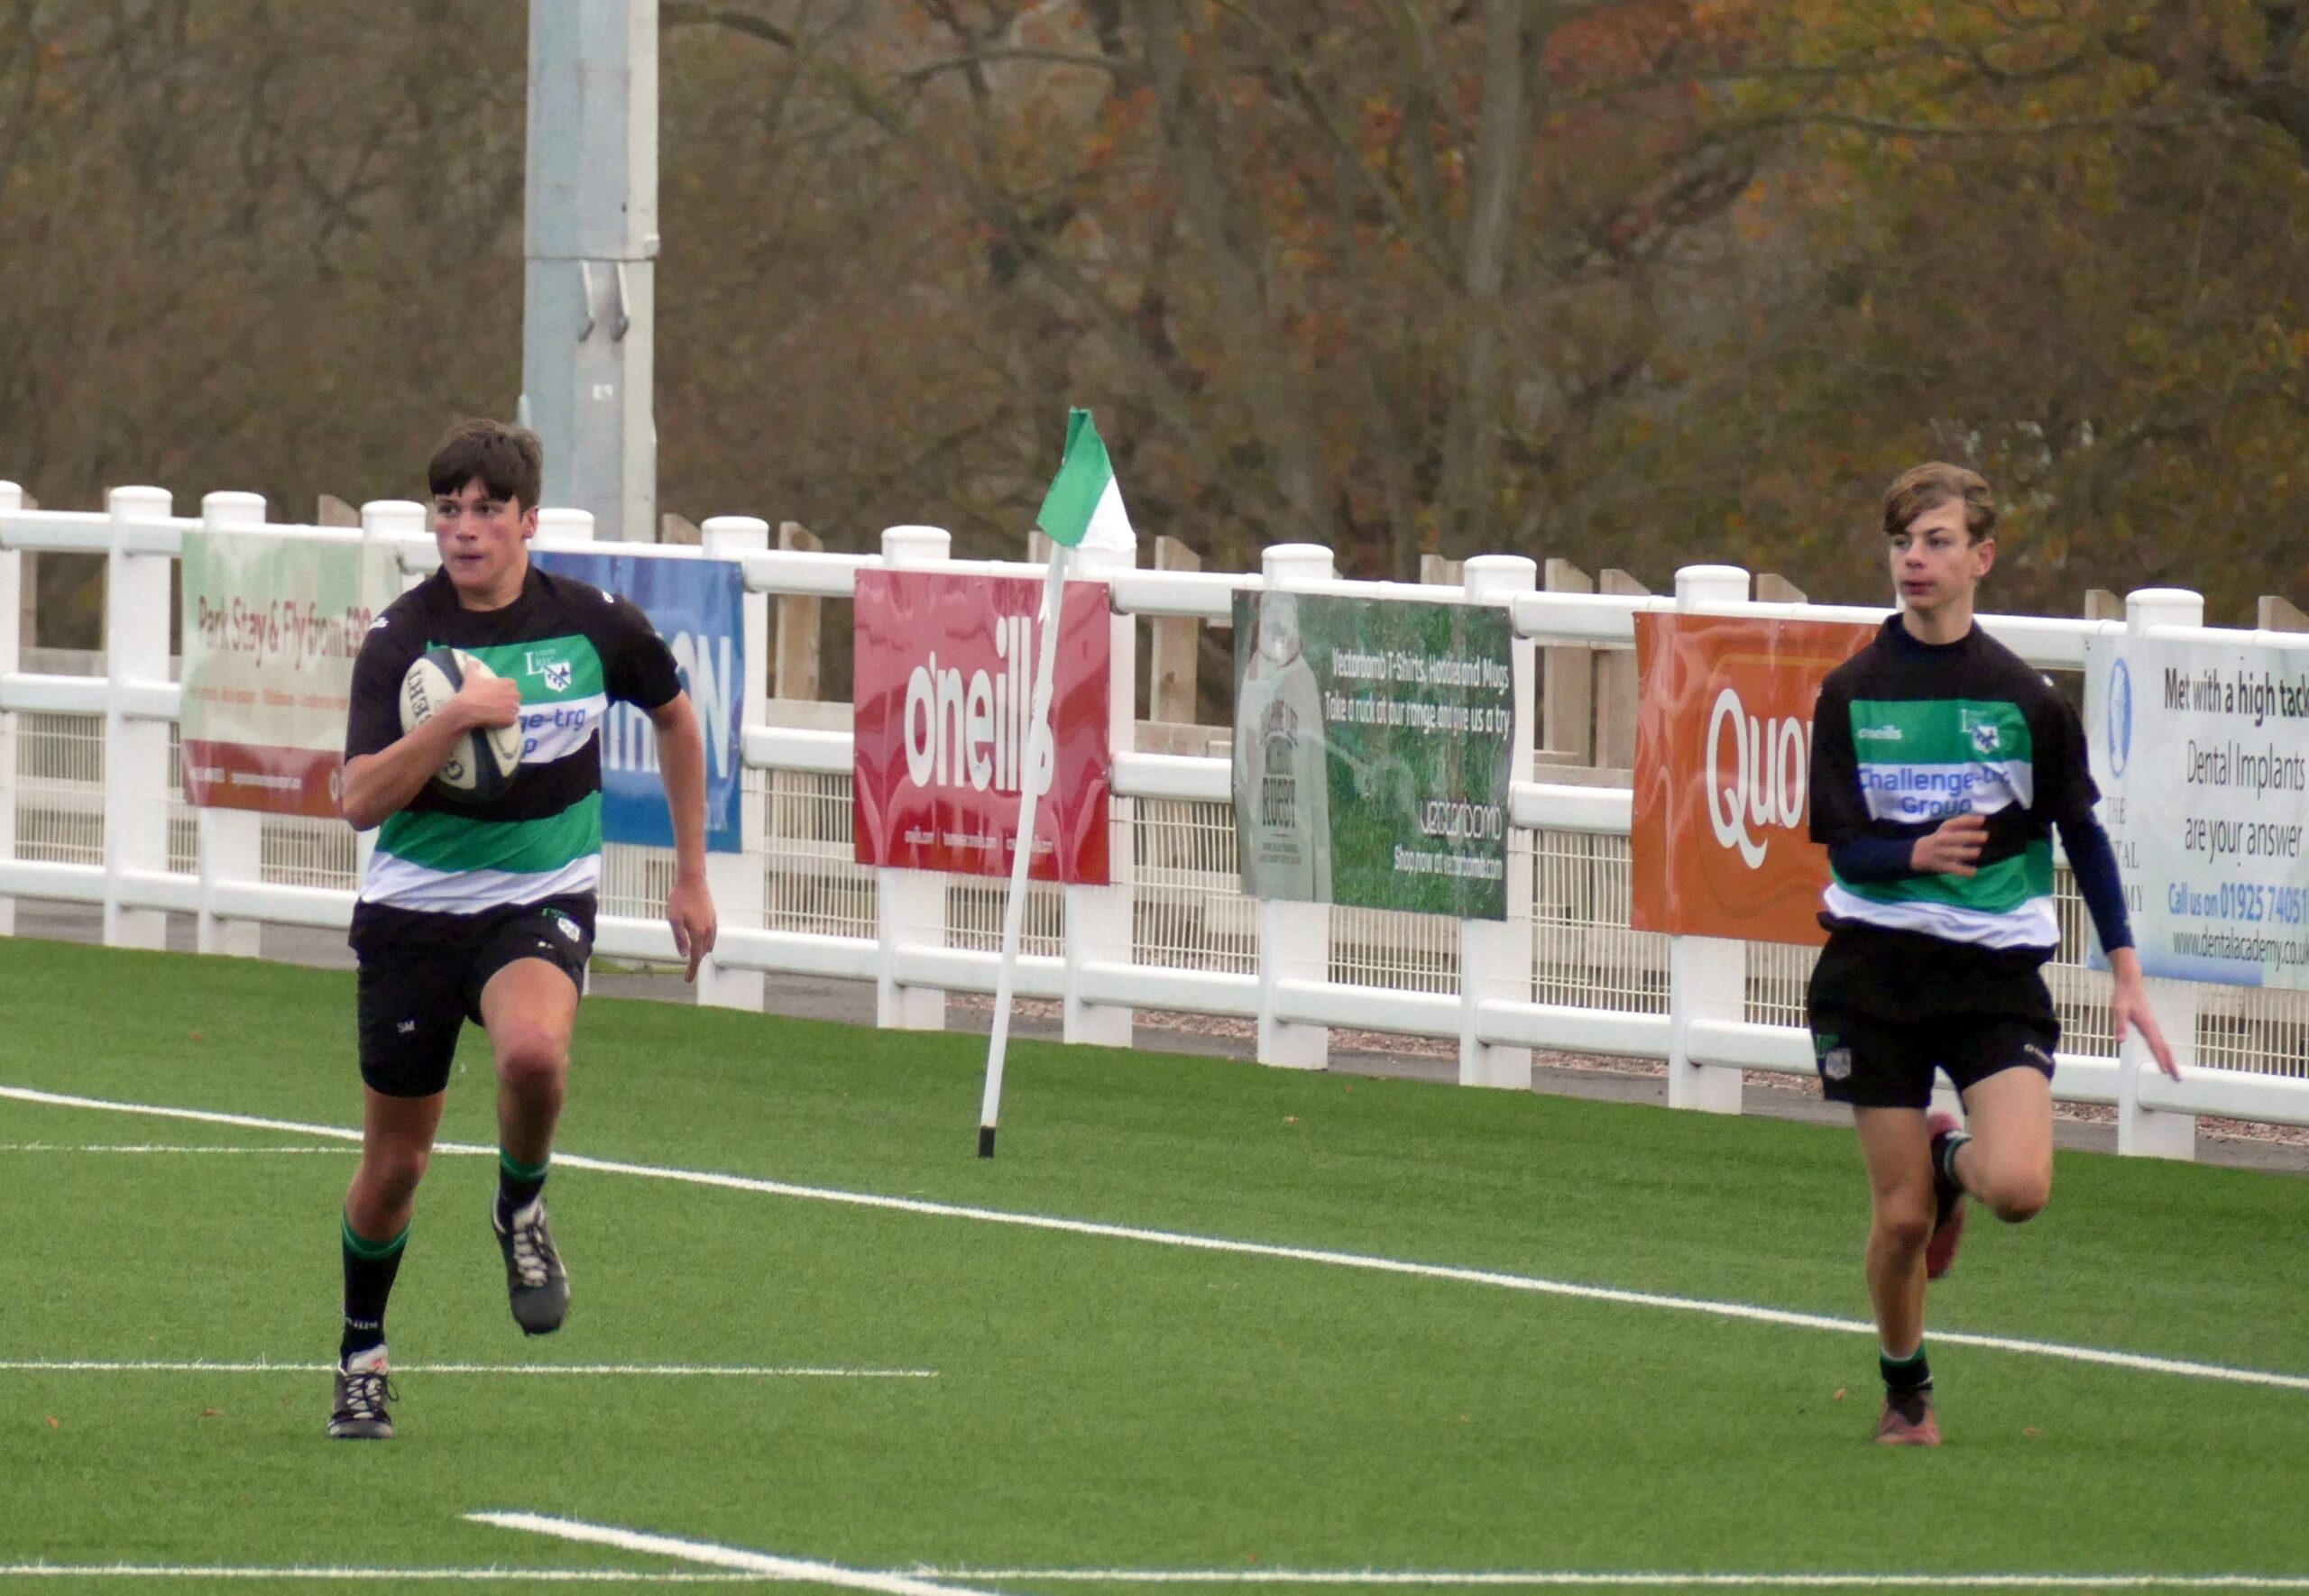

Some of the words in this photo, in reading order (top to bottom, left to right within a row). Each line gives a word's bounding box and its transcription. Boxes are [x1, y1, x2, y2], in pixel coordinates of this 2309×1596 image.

[1483, 657, 1510, 696] Mugs
[2165, 667, 2190, 711] Met
[2193, 669, 2222, 713] with
[2225, 681, 2233, 713] a
[2238, 670, 2276, 727] high
[519, 708, 586, 733] ge-trg
[1471, 707, 1484, 732] us
[1706, 688, 1813, 869] Quo
[2187, 739, 2231, 785] Dental
[2236, 742, 2305, 800] Implants
[2106, 797, 2126, 824] THE
[2111, 840, 2139, 868] TAL
[2185, 817, 2206, 851] are
[2208, 819, 2243, 864] your
[2247, 821, 2303, 858] answer
[2168, 881, 2187, 915] Call
[2190, 893, 2202, 916] us
[2204, 894, 2218, 918] on
[2221, 881, 2264, 922] 01925
[2268, 885, 2309, 924] 74051
